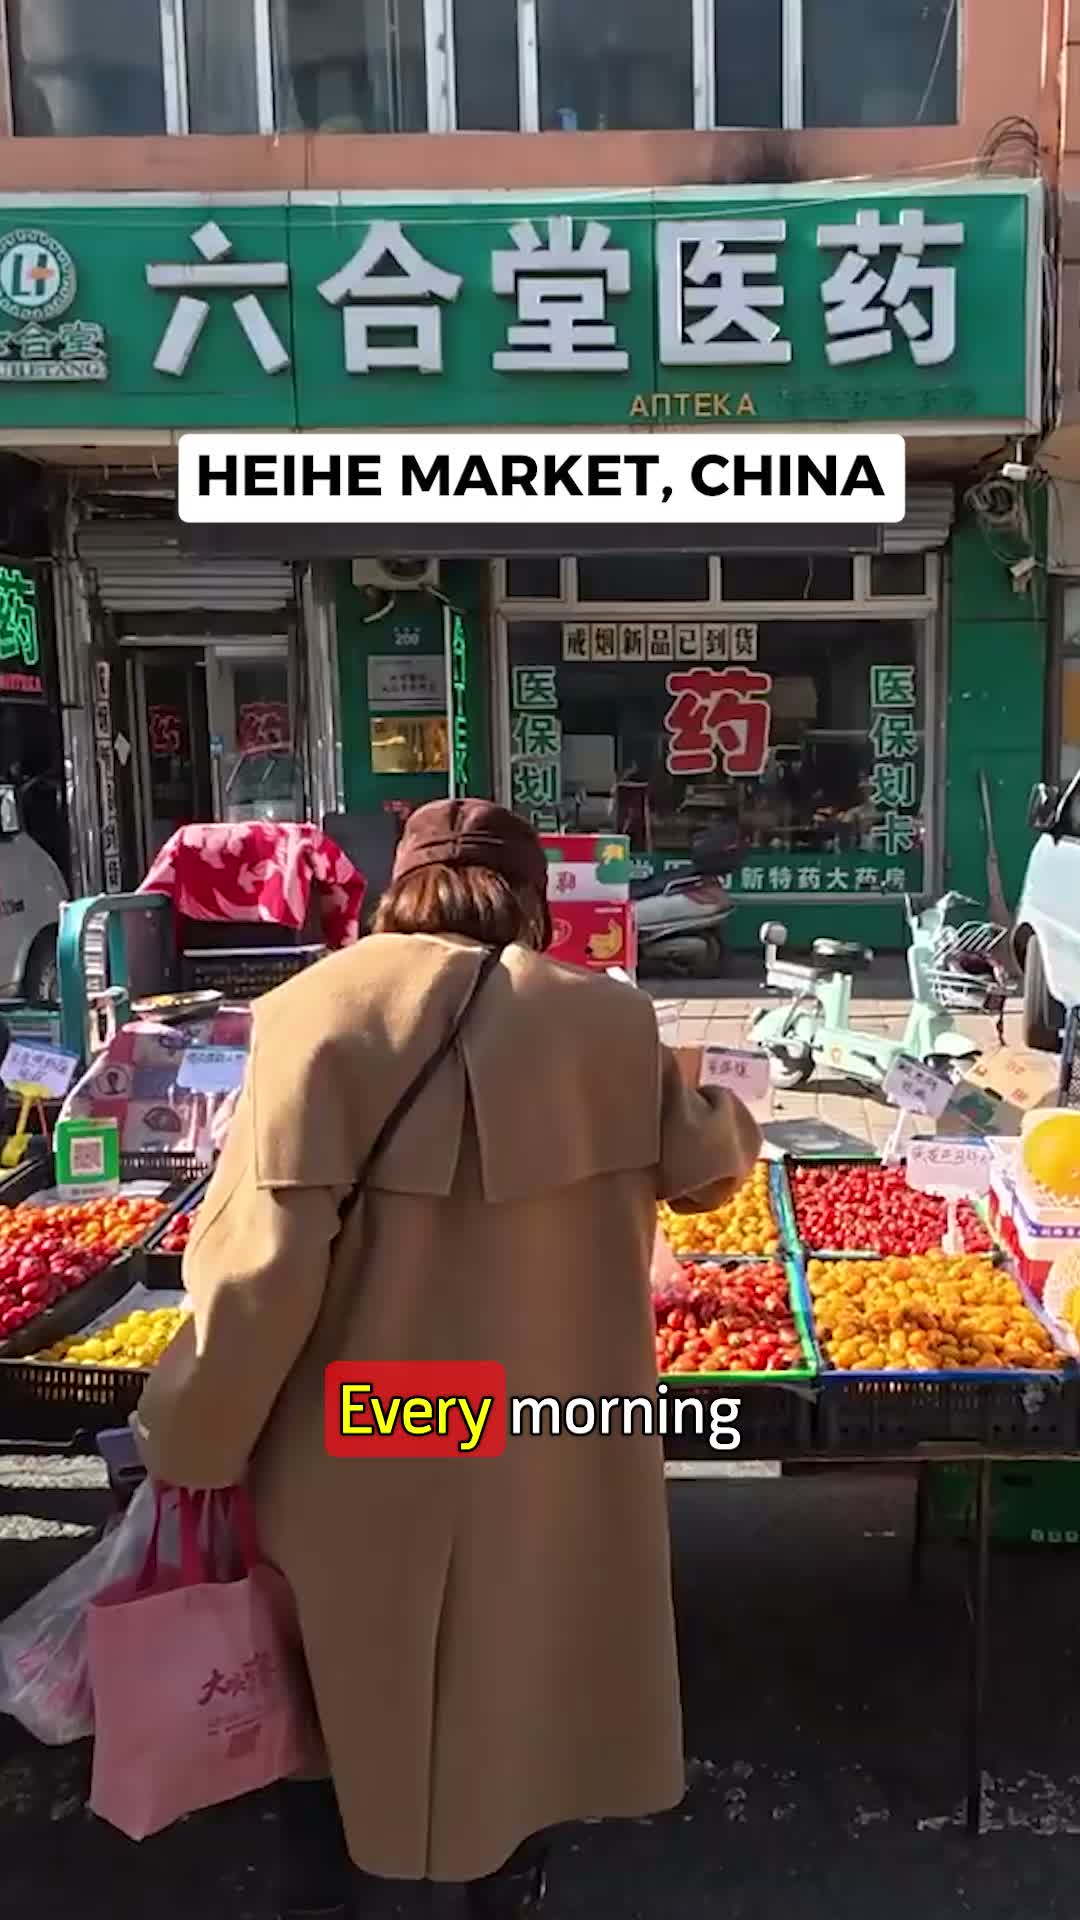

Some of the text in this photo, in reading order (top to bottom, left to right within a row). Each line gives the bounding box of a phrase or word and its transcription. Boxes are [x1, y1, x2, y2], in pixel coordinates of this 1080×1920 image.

[145, 208, 966, 376] 六合堂医药
[629, 392, 757, 417] АПТЕКА
[563, 626, 757, 659] 戒烟新品已到货
[665, 667, 772, 775] 药
[869, 665, 919, 856] 医保划卡
